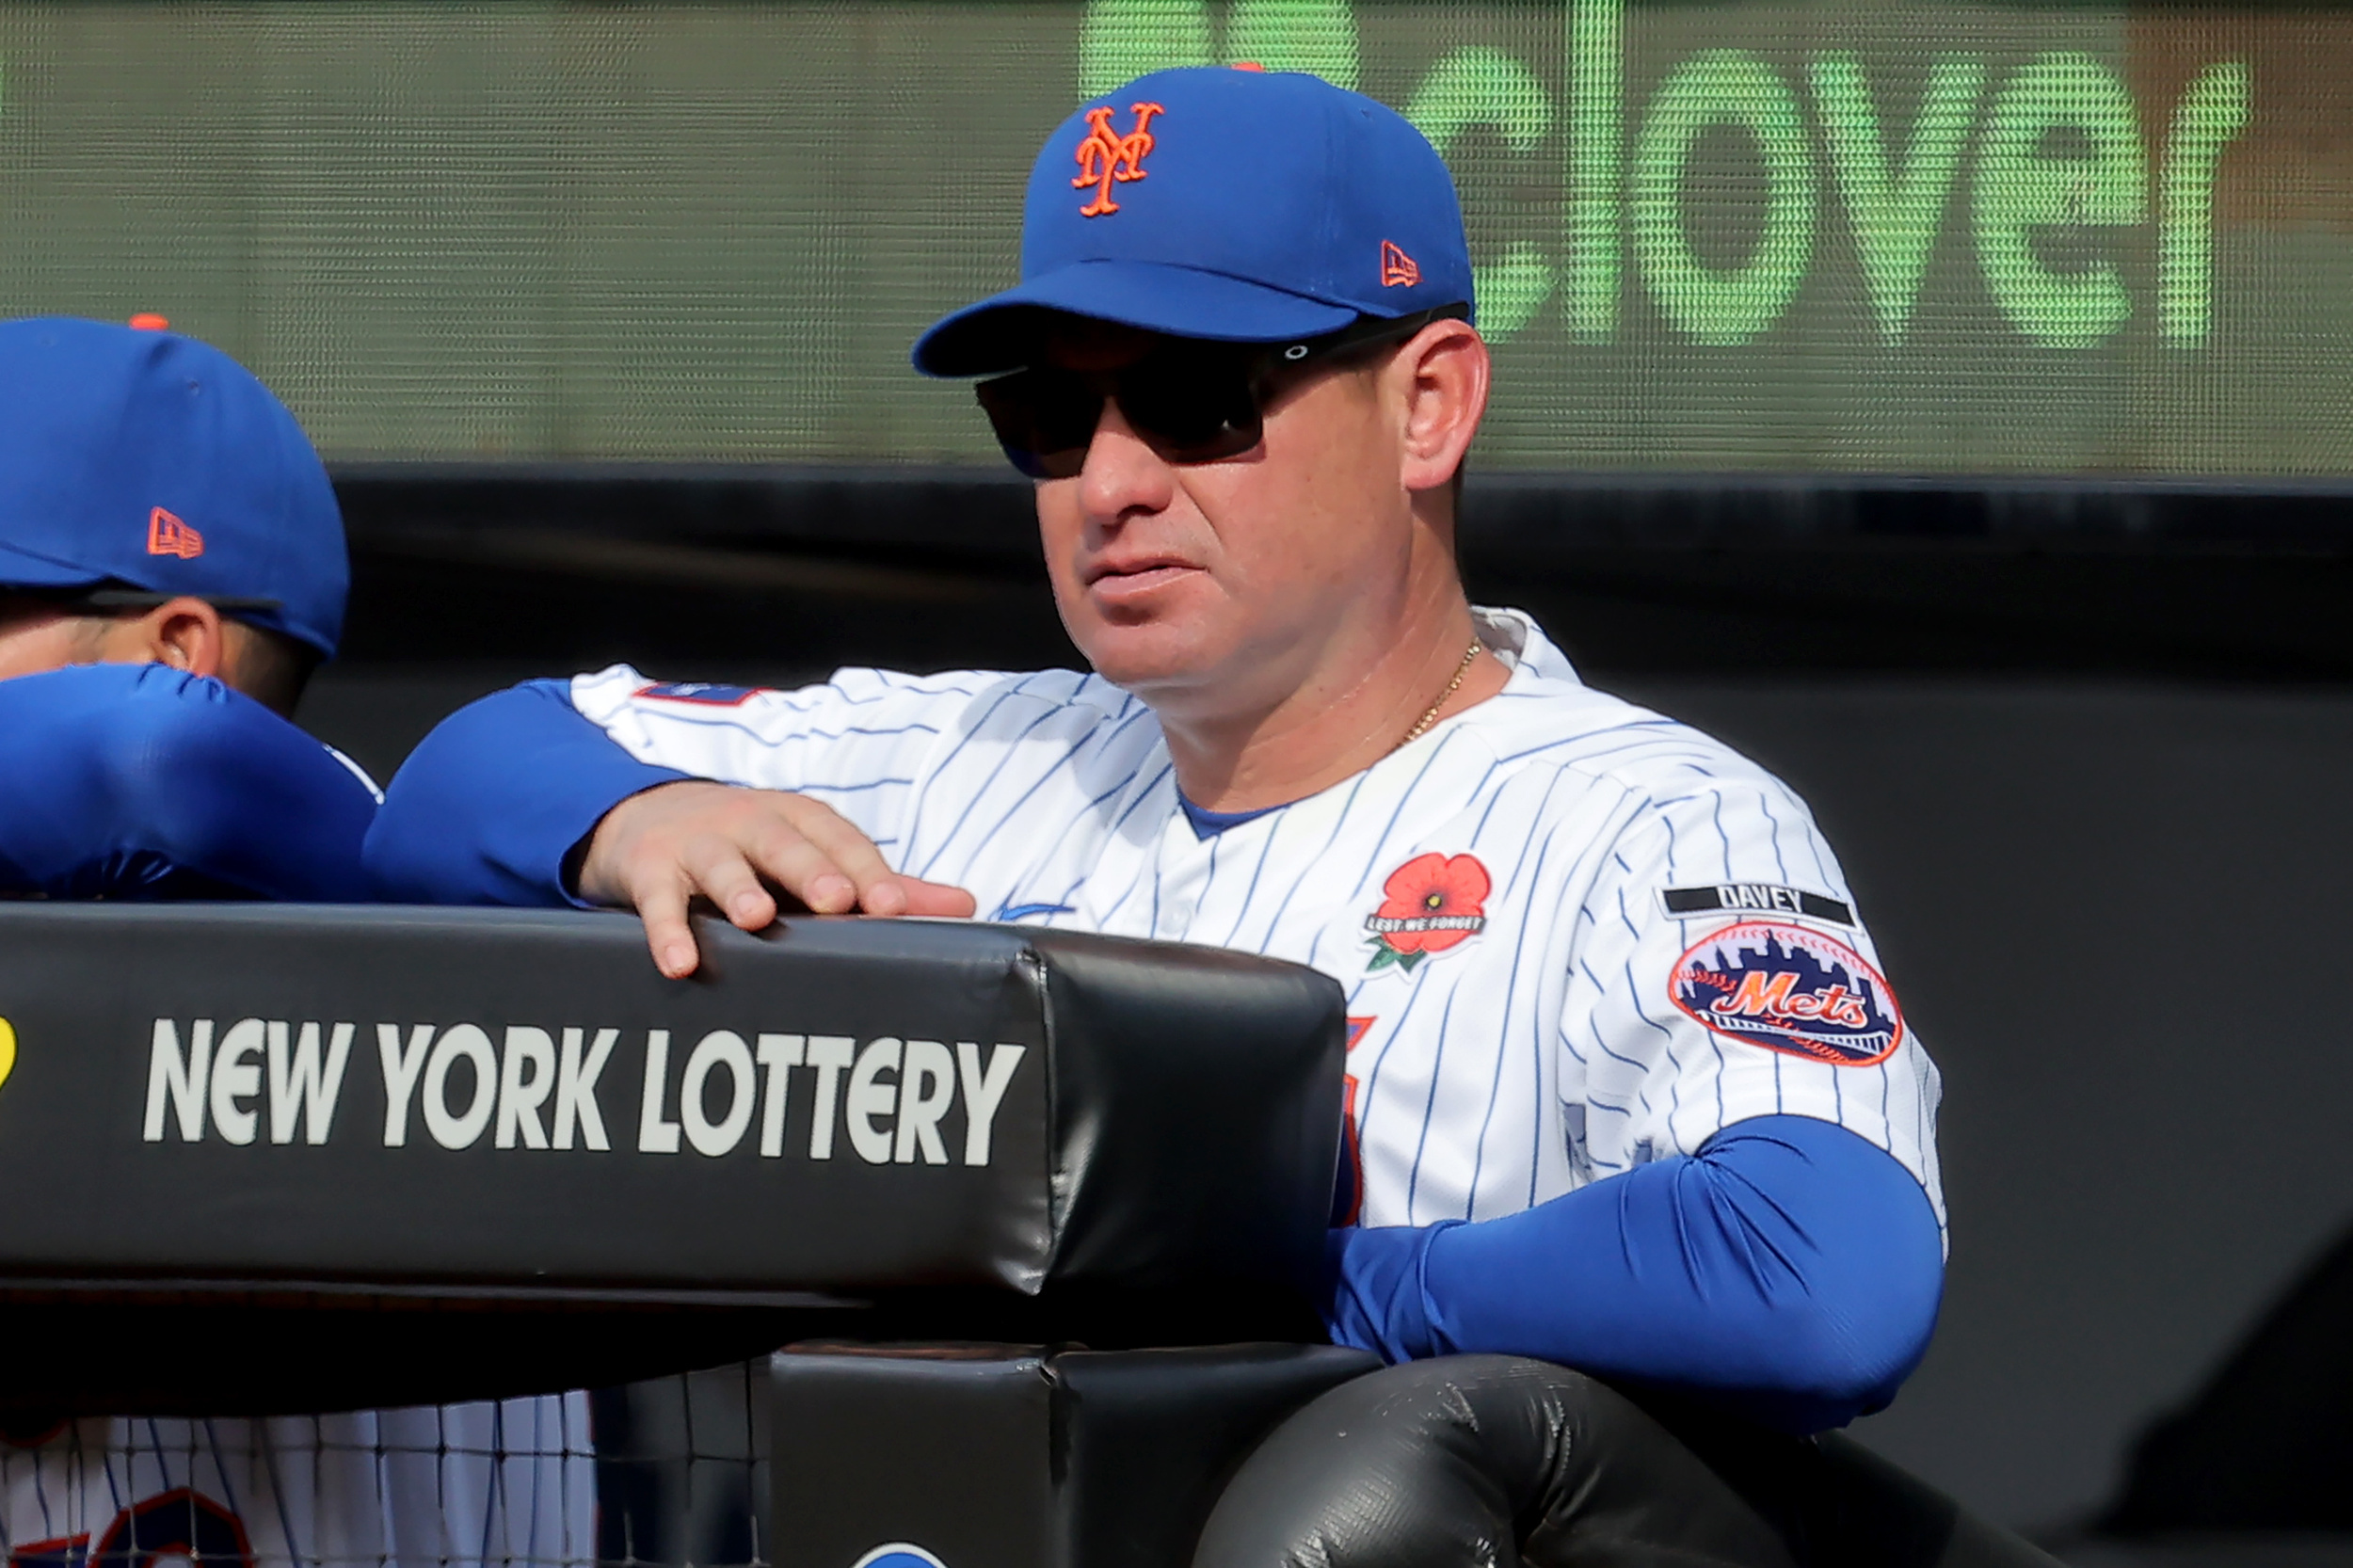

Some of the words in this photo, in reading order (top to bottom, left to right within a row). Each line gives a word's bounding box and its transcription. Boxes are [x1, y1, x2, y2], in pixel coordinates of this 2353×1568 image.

[1717, 886, 1802, 913] DAVEY
[1368, 916, 1402, 933] LEST
[1405, 918, 1428, 931] WE
[1429, 916, 1483, 931] FORGET
[1710, 970, 1868, 1029] Mets
[143, 1017, 357, 1145] NEW
[376, 1022, 621, 1151] YORK
[638, 1029, 1028, 1167] LOTTERY
